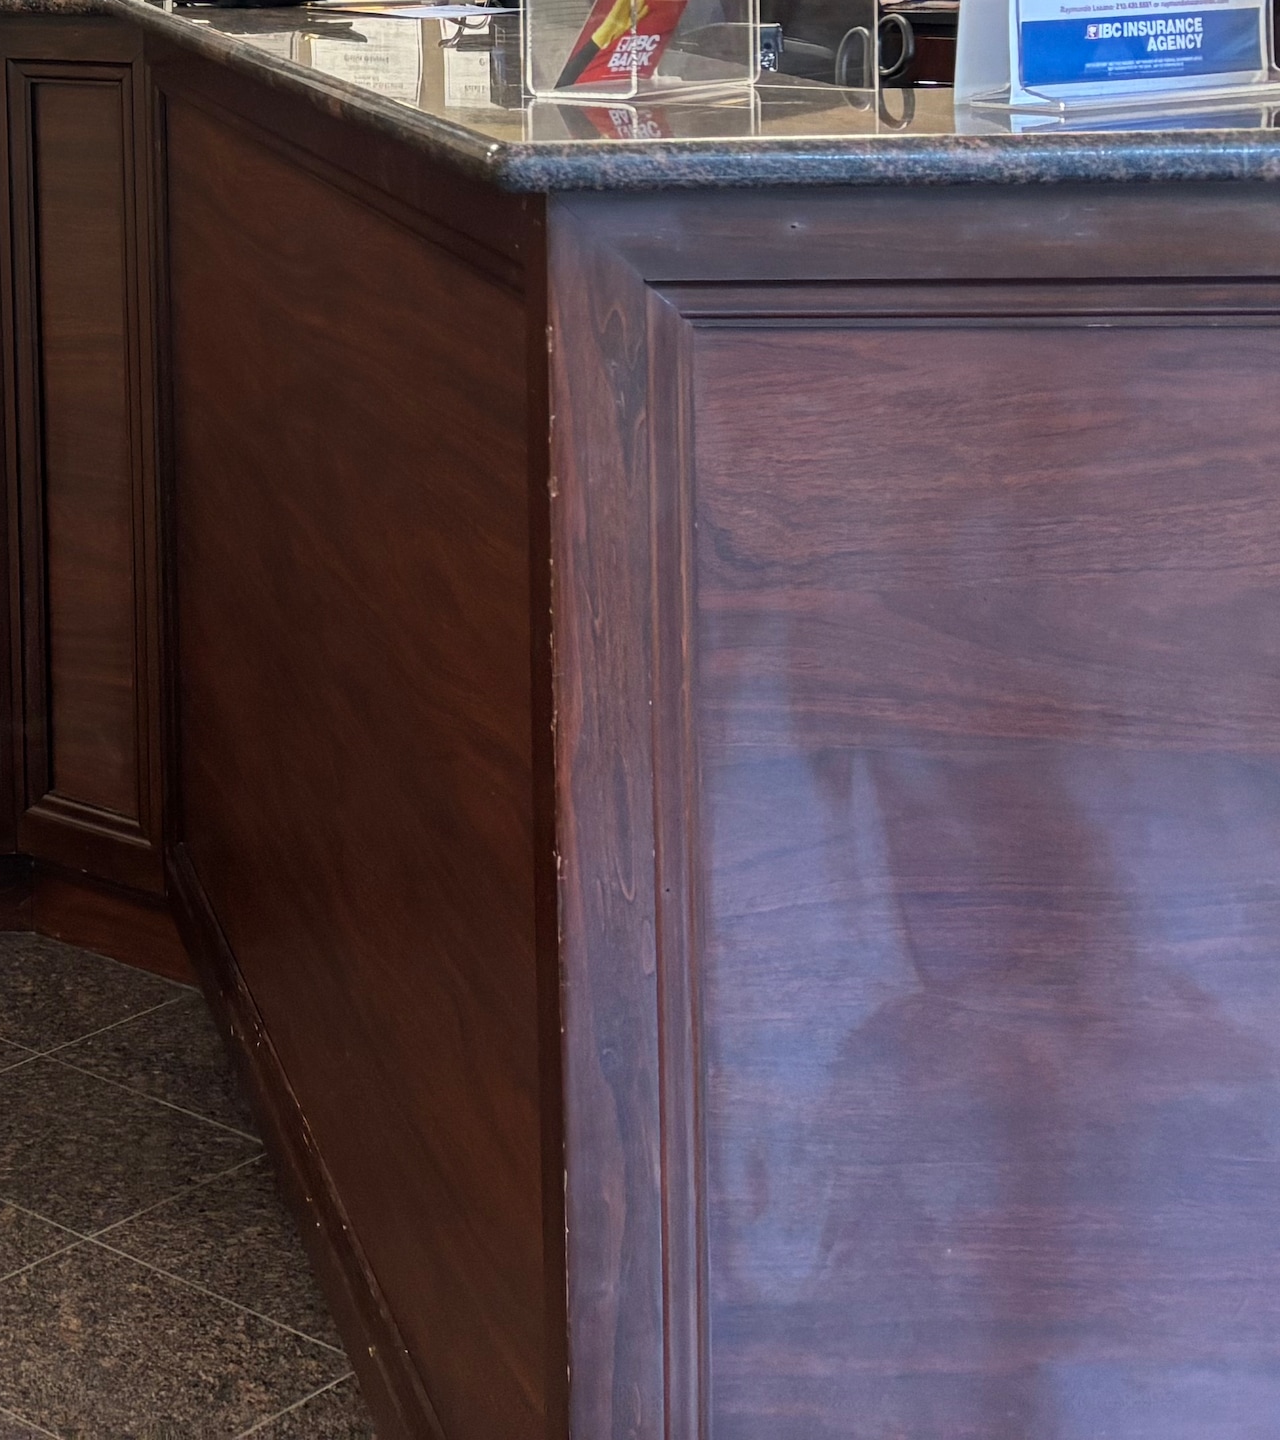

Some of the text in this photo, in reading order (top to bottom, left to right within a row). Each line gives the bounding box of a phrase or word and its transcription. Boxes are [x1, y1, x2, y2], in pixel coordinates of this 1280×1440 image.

[1098, 17, 1203, 39] IBC INSURANCE
[1146, 33, 1203, 52] AGENCY
